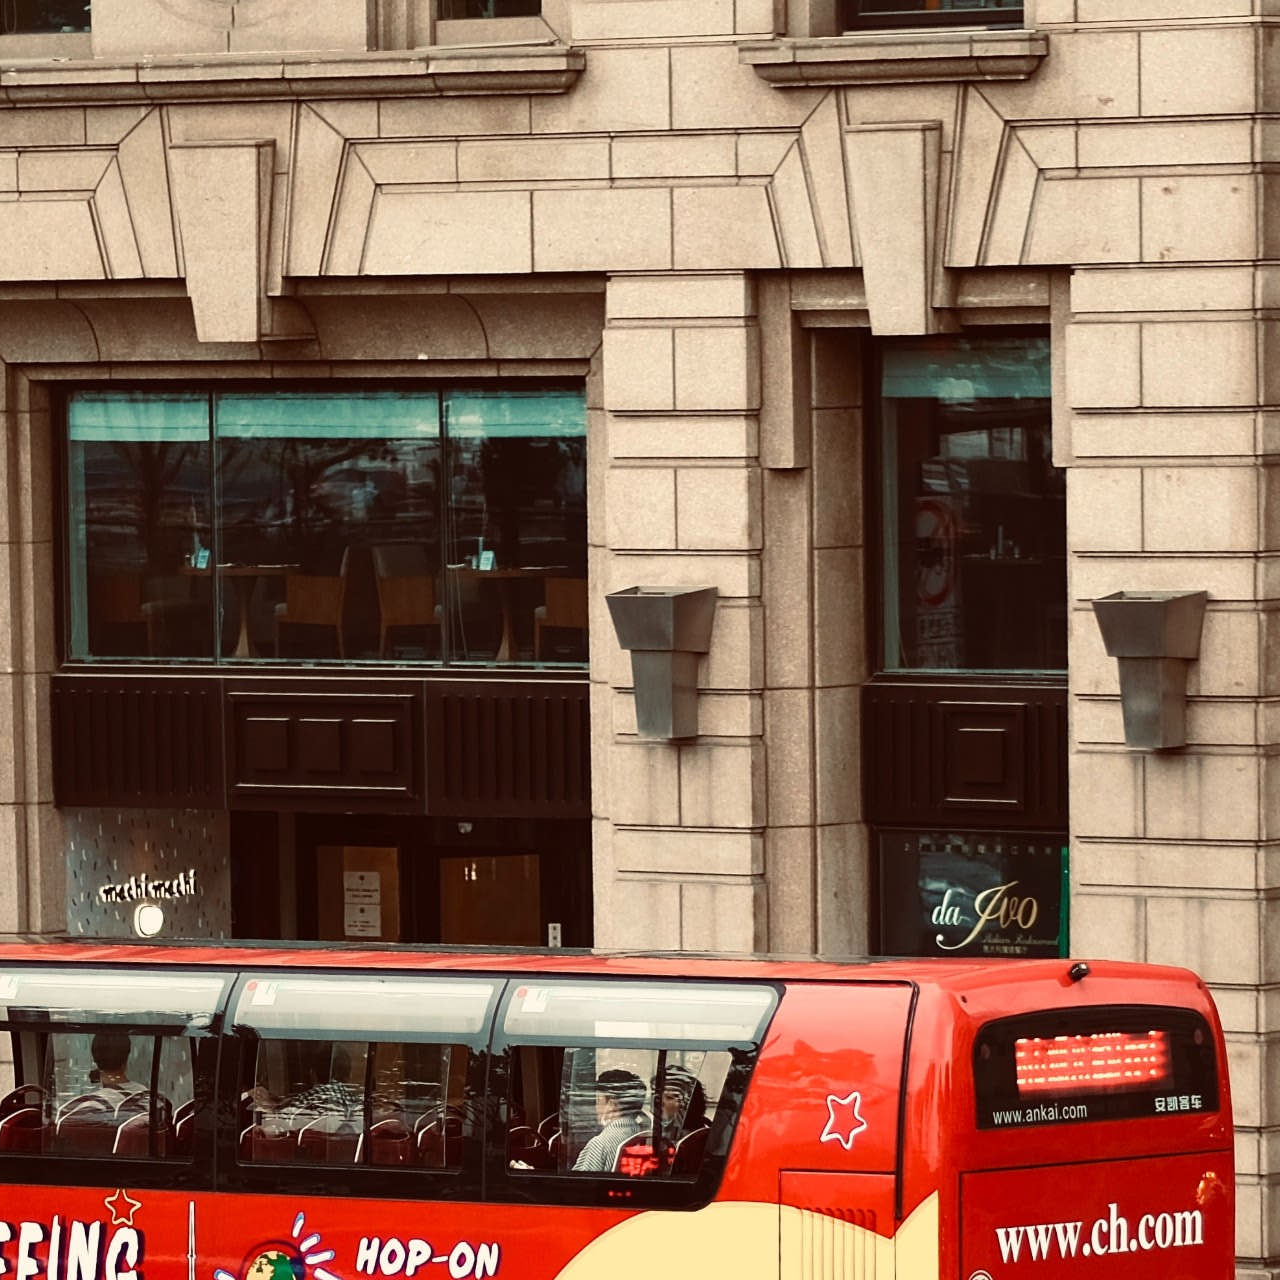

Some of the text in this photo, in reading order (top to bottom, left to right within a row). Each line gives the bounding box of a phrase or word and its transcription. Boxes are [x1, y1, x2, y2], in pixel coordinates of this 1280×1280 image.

[931, 888, 969, 926] da
[992, 1103, 1088, 1126] www.ankai.com
[1154, 1094, 1202, 1112] 安凯客车
[995, 1202, 1204, 1264] www.ch.com
[355, 1236, 500, 1280] HOP-ON
